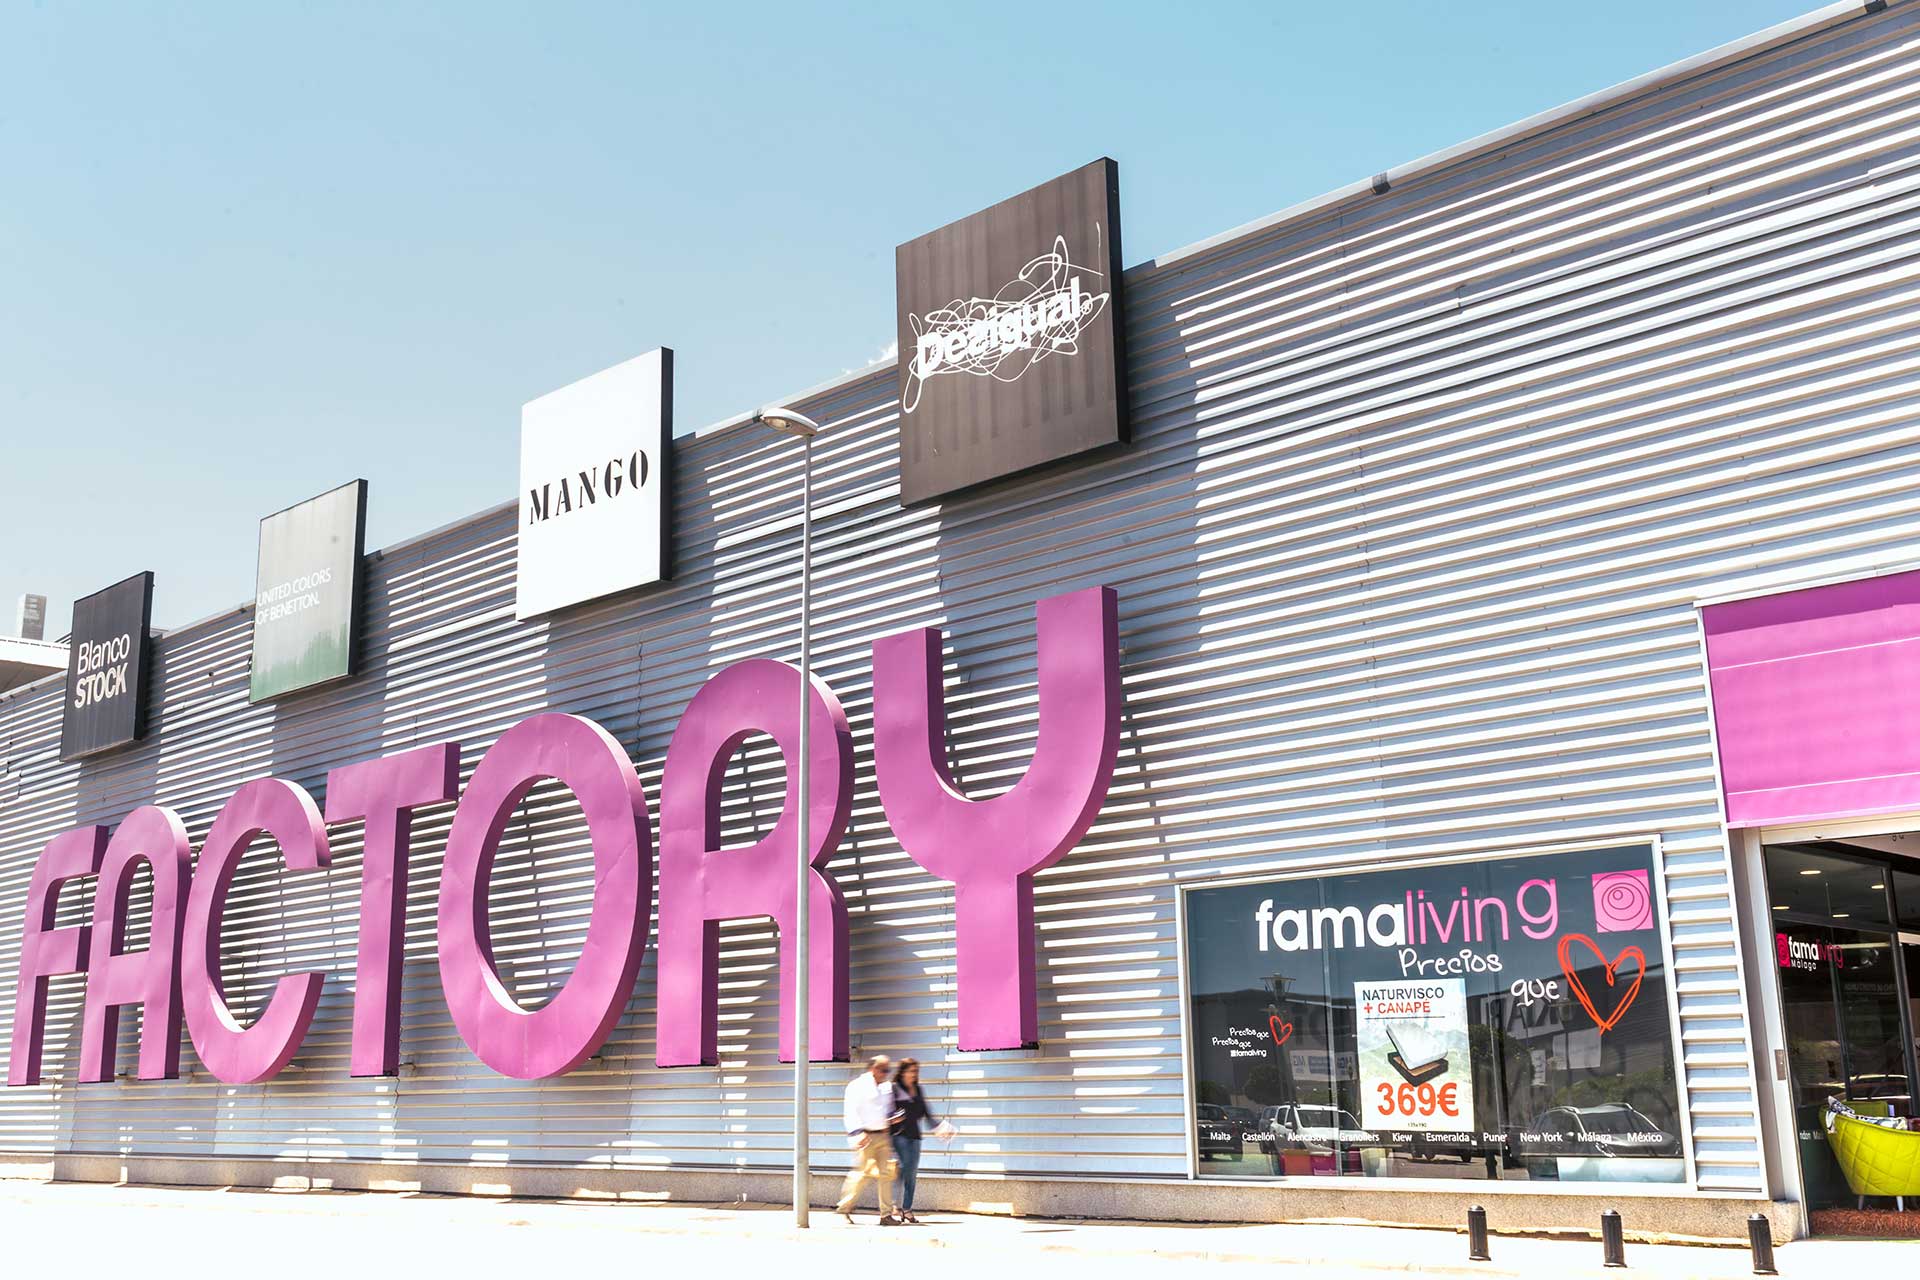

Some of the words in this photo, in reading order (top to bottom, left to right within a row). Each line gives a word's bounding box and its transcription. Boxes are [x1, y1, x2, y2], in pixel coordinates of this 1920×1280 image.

[530, 449, 649, 525] MANGO
[256, 582, 292, 607] UNITED
[292, 567, 332, 594] COLORS
[255, 610, 270, 625] OF
[77, 633, 130, 675] Blanco
[74, 662, 129, 709] STOCK
[7, 585, 1121, 1086] FACTORY
[1255, 878, 1559, 952] famaliving
[1362, 987, 1445, 1001] NATURVISCO
[1398, 948, 1503, 977] Precios
[1510, 978, 1560, 1007] que
[1377, 998, 1432, 1014] CANAPÉ
[1211, 1037, 1239, 1046] Precios
[1238, 1041, 1252, 1050] que
[1229, 1026, 1257, 1037] Precios
[1256, 1031, 1270, 1041] que
[1376, 1082, 1460, 1117] 369€
[1210, 1131, 1231, 1141] Malta
[1241, 1132, 1276, 1142] Castellón
[1392, 1132, 1413, 1142] Kiew
[1426, 1132, 1470, 1142] Esmeralda
[1483, 1132, 1506, 1142] Pune
[1519, 1132, 1541, 1142] New
[1541, 1132, 1563, 1142] York
[1577, 1131, 1612, 1144] Málaga
[1626, 1131, 1663, 1142] México
